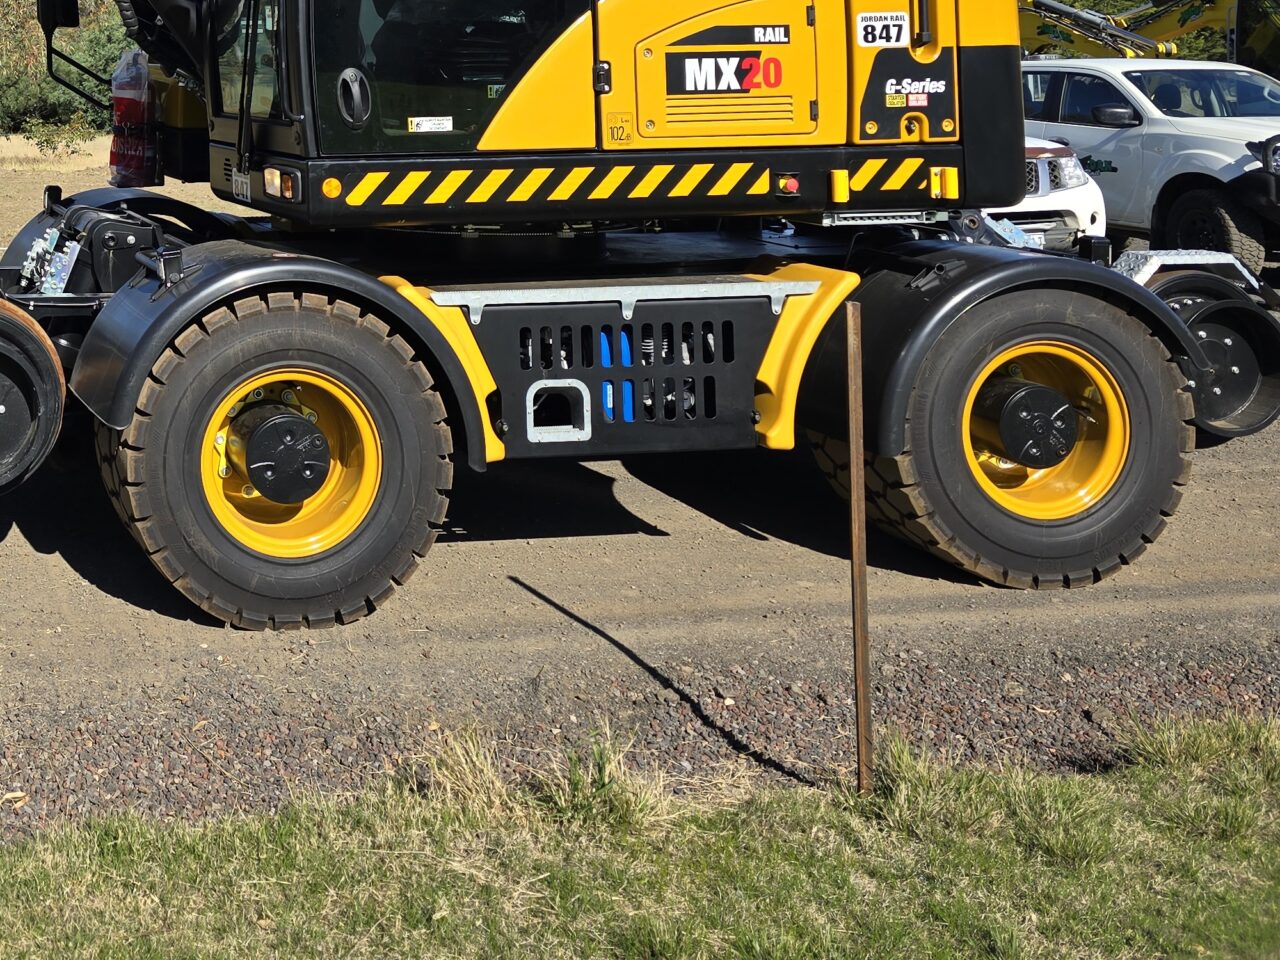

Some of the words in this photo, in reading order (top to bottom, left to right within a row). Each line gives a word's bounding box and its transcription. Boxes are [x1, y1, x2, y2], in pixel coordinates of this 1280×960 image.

[860, 15, 889, 23] JORDAN
[890, 14, 907, 22] RAIL
[753, 26, 789, 43] RAIL
[862, 23, 904, 44] 847
[685, 56, 783, 91] MX20
[885, 78, 946, 94] G-Series
[609, 125, 625, 141] 102
